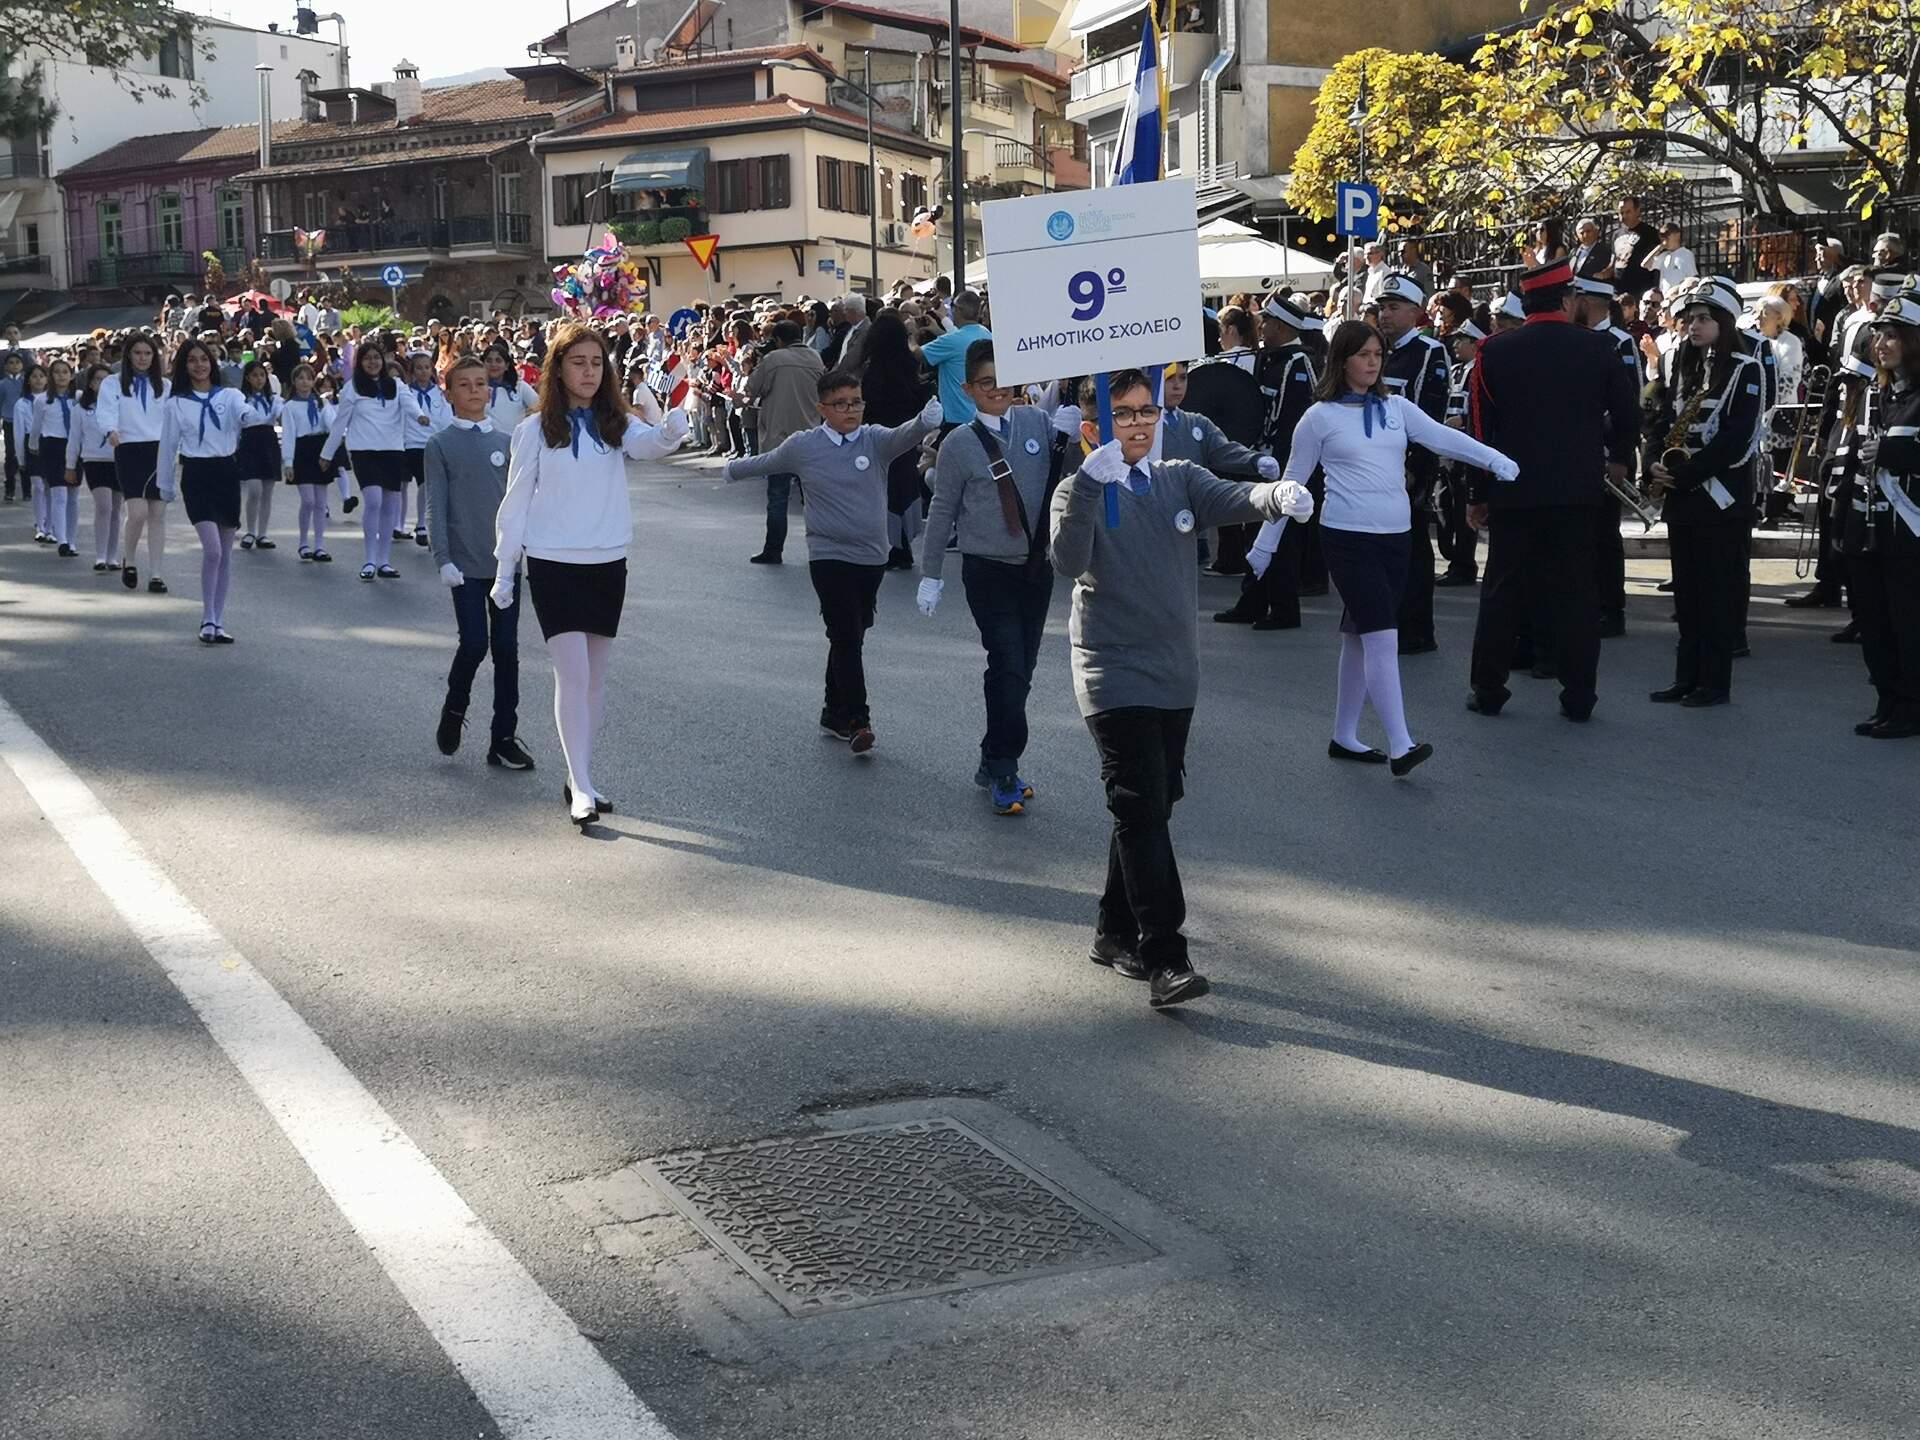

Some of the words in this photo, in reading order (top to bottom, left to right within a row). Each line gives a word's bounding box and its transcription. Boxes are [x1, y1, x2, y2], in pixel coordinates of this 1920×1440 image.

[1345, 189, 1372, 230] P
[1200, 281, 1220, 290] epsi
[1017, 328, 1104, 351] ΔΗΜΟΤΙΚΟ
[1109, 317, 1181, 339] ΣΧΟΛΕΙΟ
